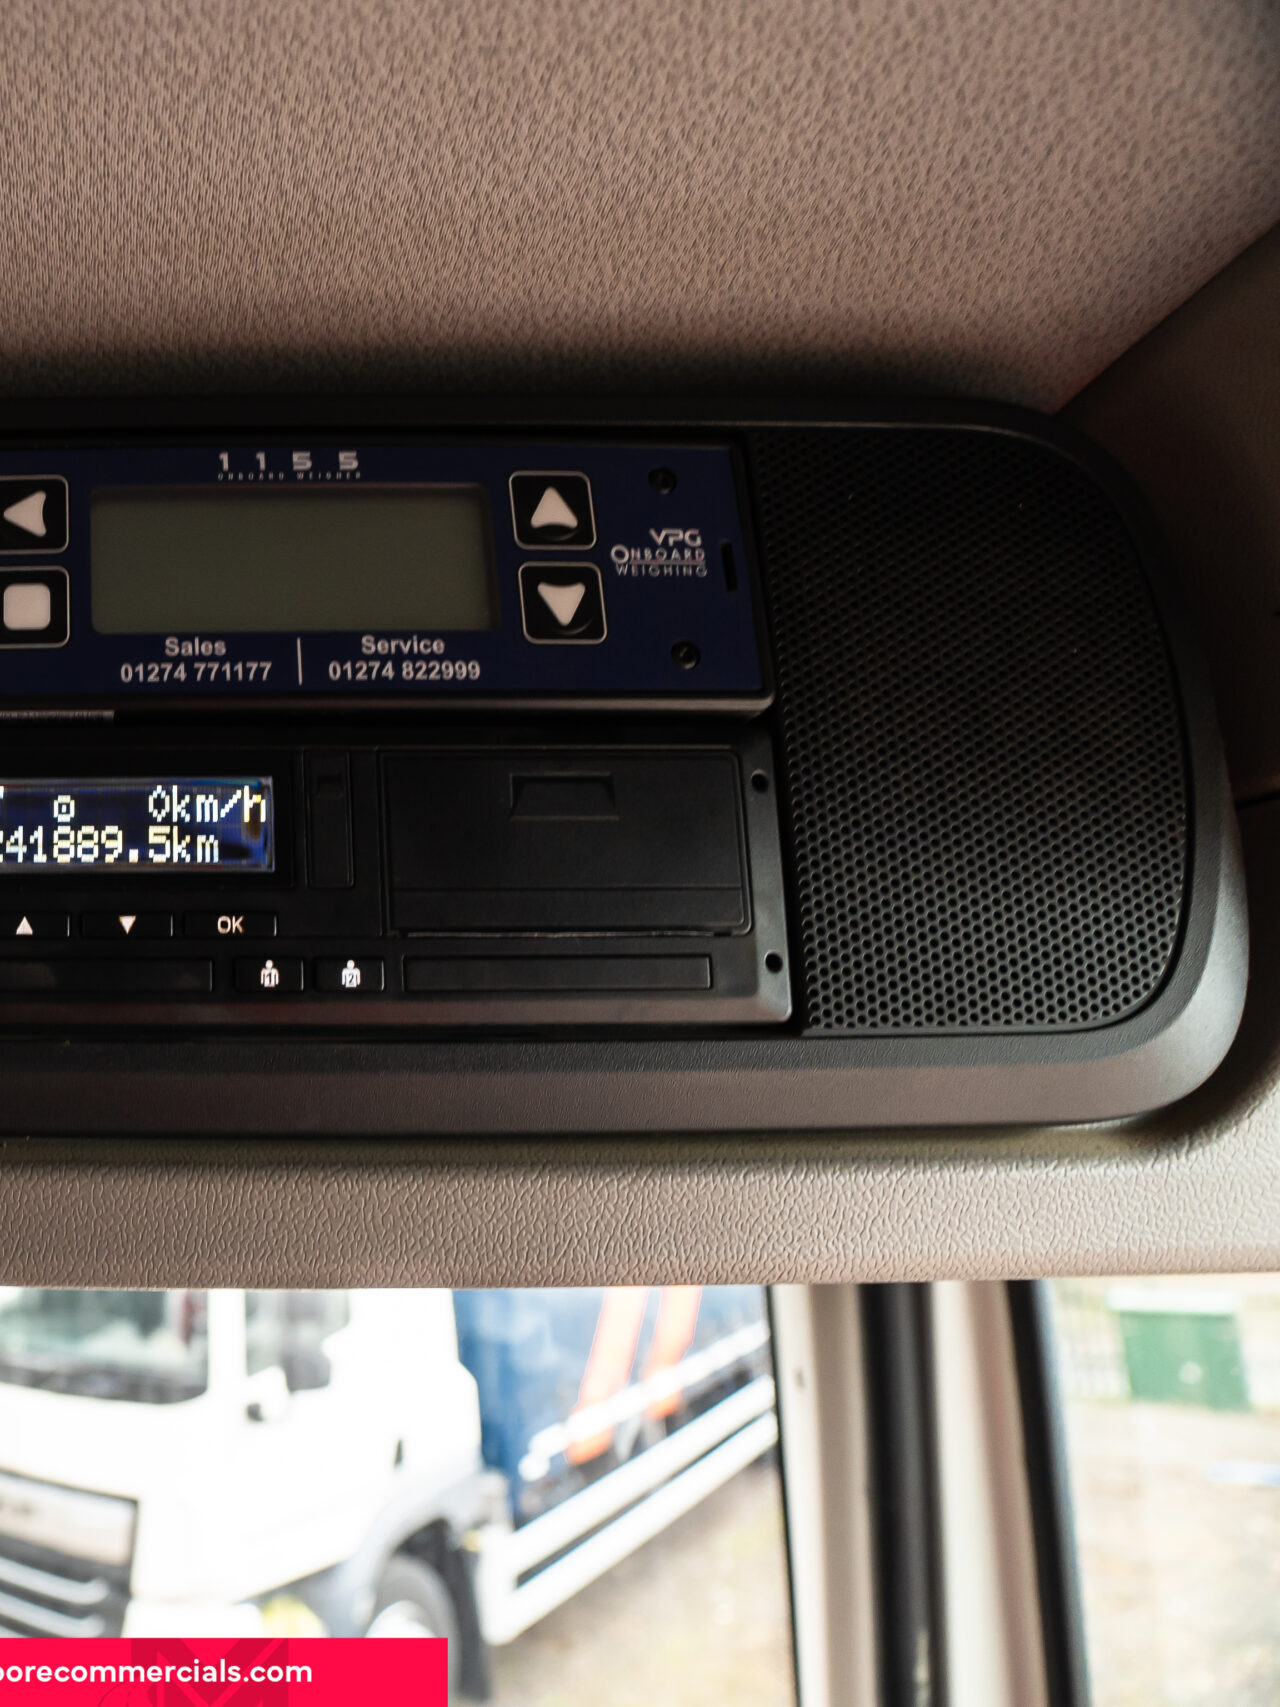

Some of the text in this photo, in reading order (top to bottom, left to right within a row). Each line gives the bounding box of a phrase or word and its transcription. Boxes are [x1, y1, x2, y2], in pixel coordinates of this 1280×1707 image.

[649, 528, 702, 547] VPG
[616, 562, 707, 577] WEIGHING
[164, 636, 226, 656] Sales
[361, 634, 445, 655] Service
[120, 661, 272, 682] 01274 771177
[328, 660, 481, 681] 01274 822999
[148, 785, 267, 823] 0km/h
[217, 915, 245, 934] OK
